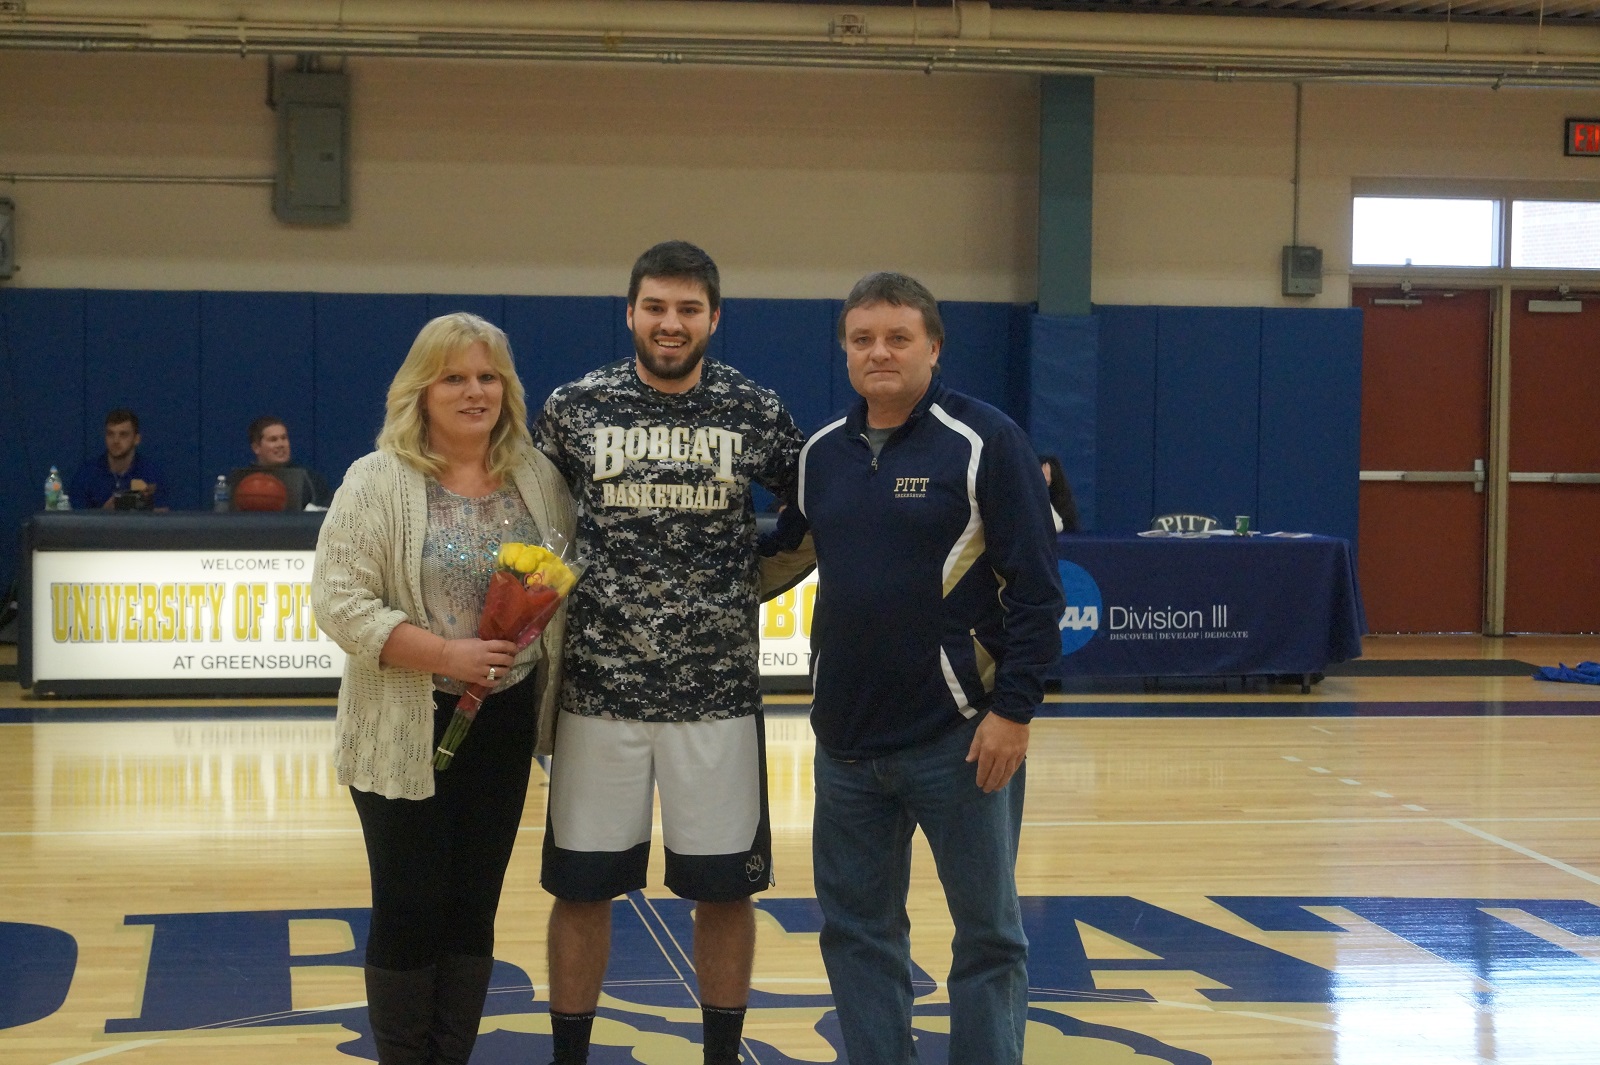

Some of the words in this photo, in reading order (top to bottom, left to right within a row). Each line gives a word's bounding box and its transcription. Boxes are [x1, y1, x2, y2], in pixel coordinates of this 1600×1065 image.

[593, 426, 742, 482] BOBCAT
[894, 477, 930, 492] PITT
[602, 483, 729, 510] BASKETBALL
[1158, 515, 1217, 533] PITT
[200, 558, 280, 570] WELCOME
[285, 558, 305, 570] TO
[50, 582, 225, 643] UNIVERSITY
[232, 582, 268, 642] OF
[274, 582, 335, 642] PIT
[1109, 605, 1203, 630] Division
[1212, 604, 1228, 628] III
[1110, 632, 1154, 641] DISCOVER
[1159, 631, 1199, 640] DEVELOP
[1205, 630, 1249, 639] DEDICATE
[173, 656, 195, 670] AT
[200, 655, 332, 670] GREENSBURG
[759, 652, 798, 667] END
